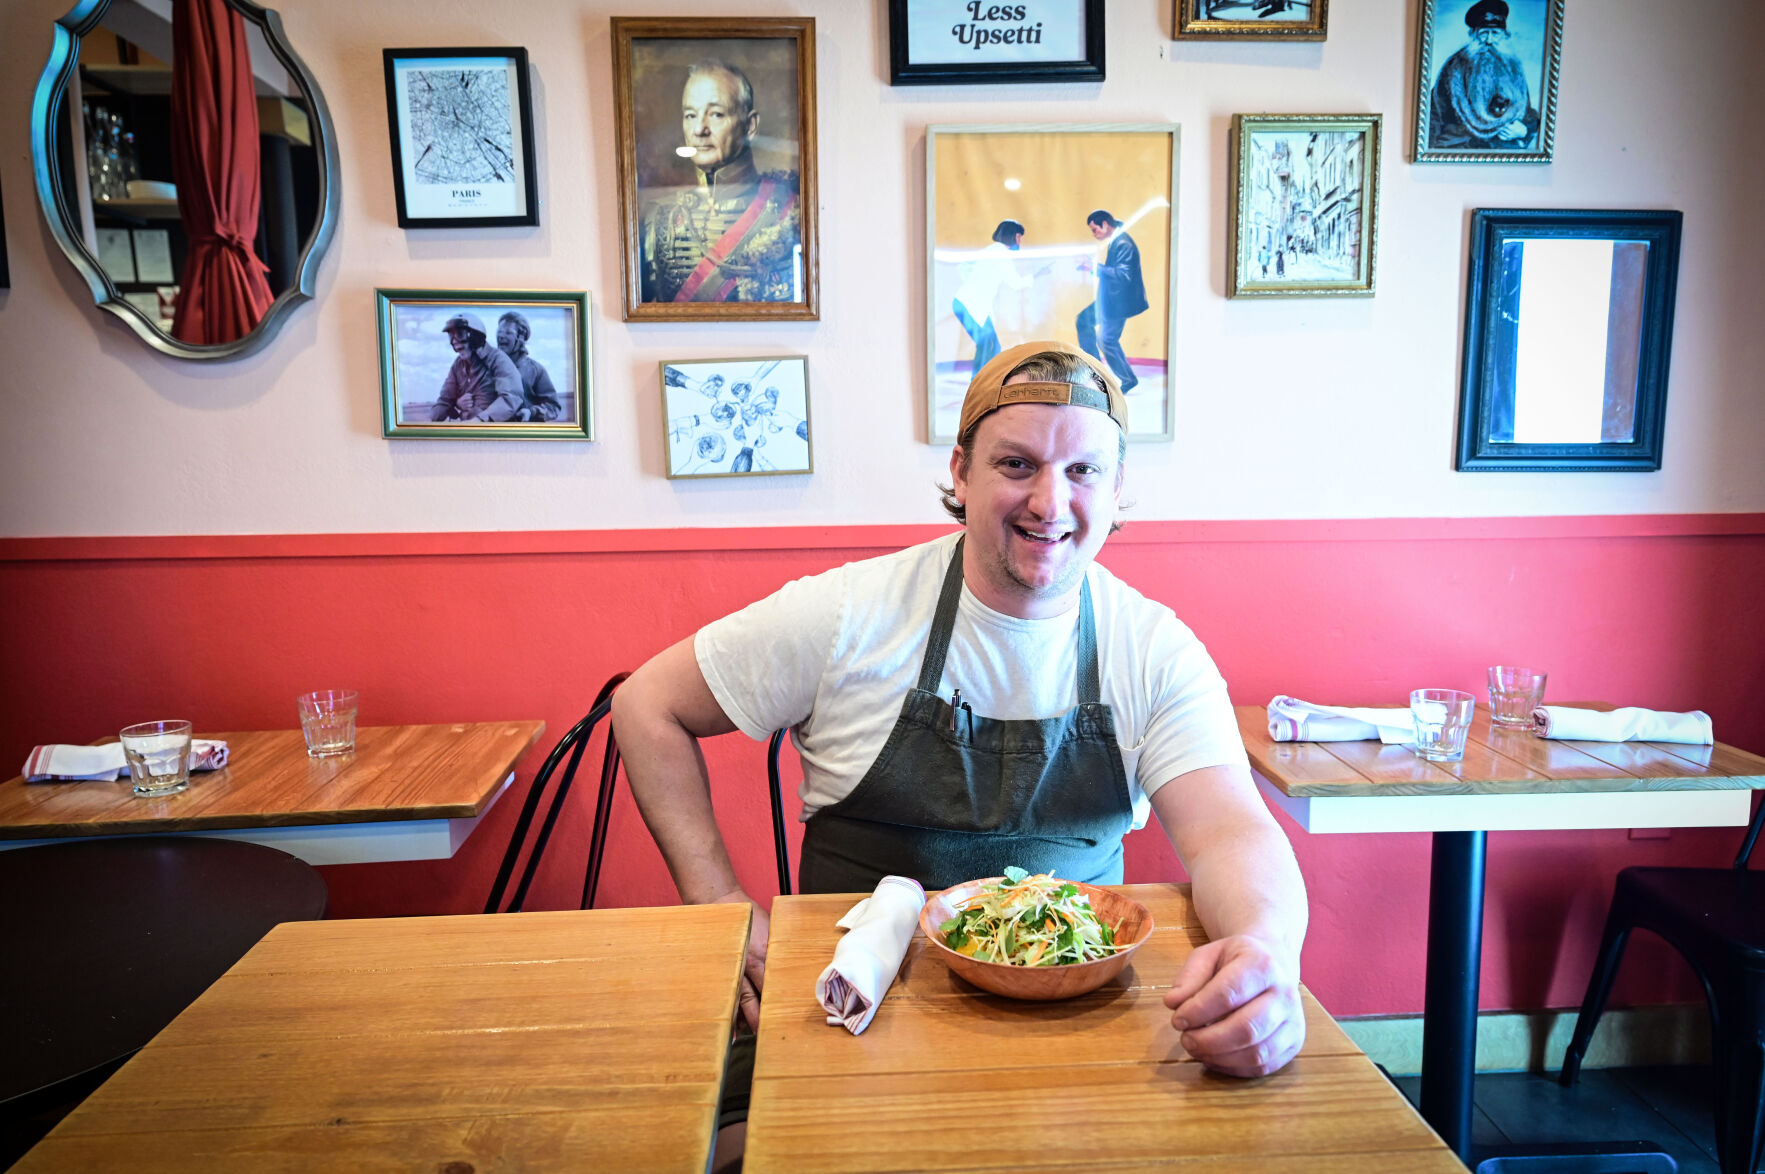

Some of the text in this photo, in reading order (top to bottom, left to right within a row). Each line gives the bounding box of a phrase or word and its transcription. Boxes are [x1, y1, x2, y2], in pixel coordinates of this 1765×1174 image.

[967, 0, 1026, 21] Less
[952, 22, 1042, 50] Upsetti
[452, 190, 481, 198] PARIS
